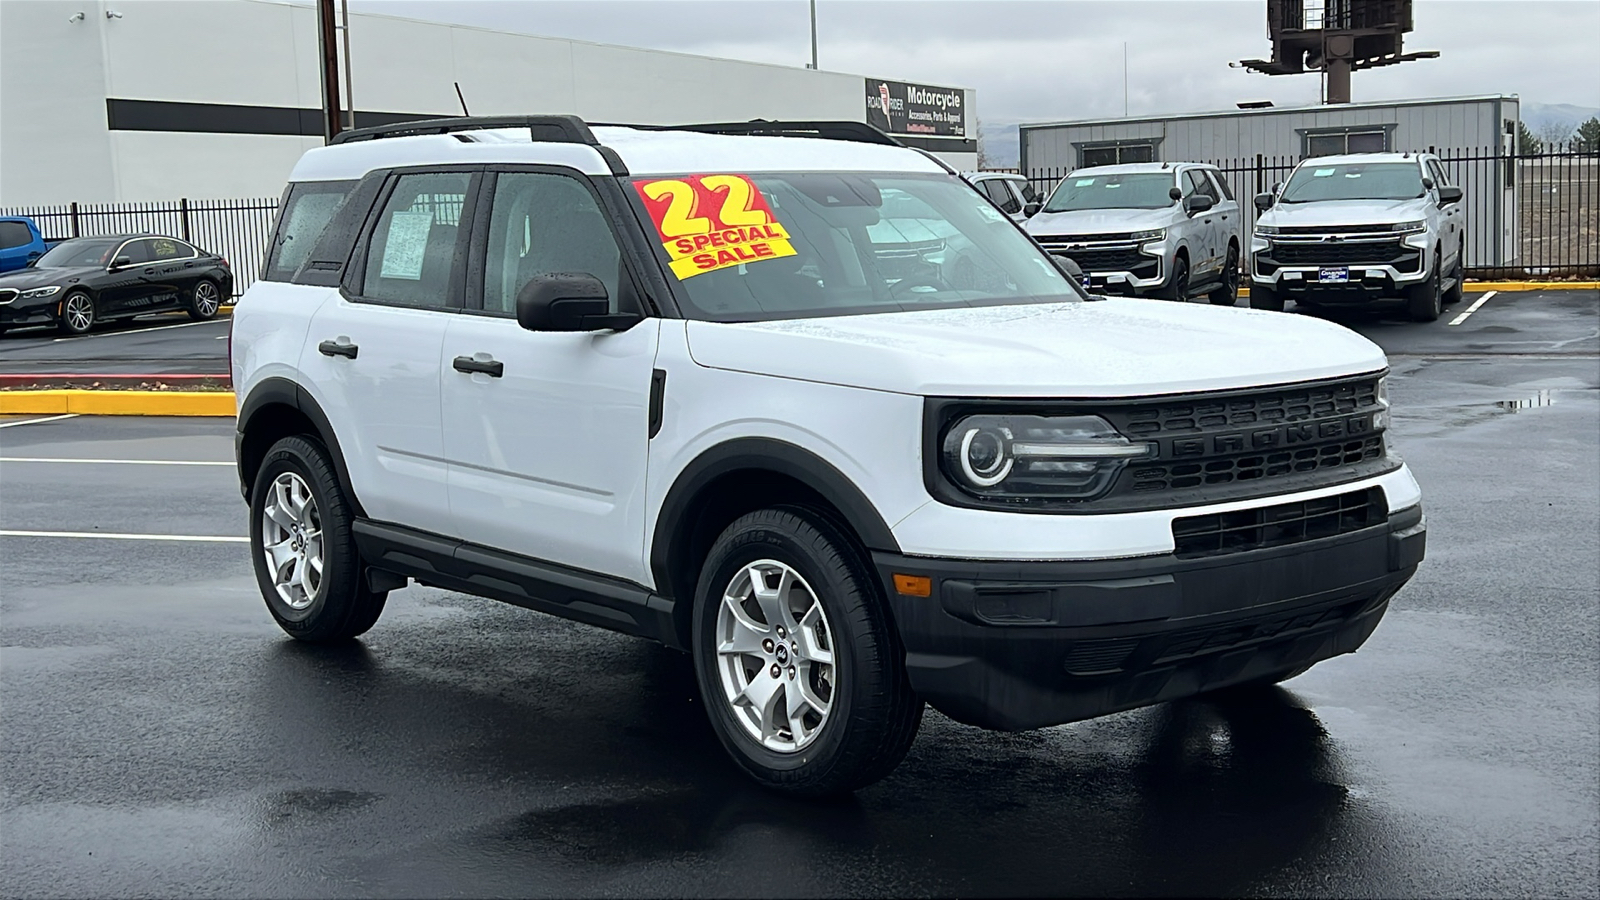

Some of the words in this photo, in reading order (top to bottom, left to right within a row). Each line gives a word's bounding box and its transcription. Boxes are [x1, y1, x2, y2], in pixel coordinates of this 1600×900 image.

[867, 96, 882, 108] ROAD
[890, 98, 904, 110] RIDER
[907, 86, 960, 110] Motorcycle
[643, 175, 772, 238] 22
[675, 225, 781, 255] SPECIAL
[692, 243, 775, 270] SALE
[1172, 416, 1368, 456] BRONCO
